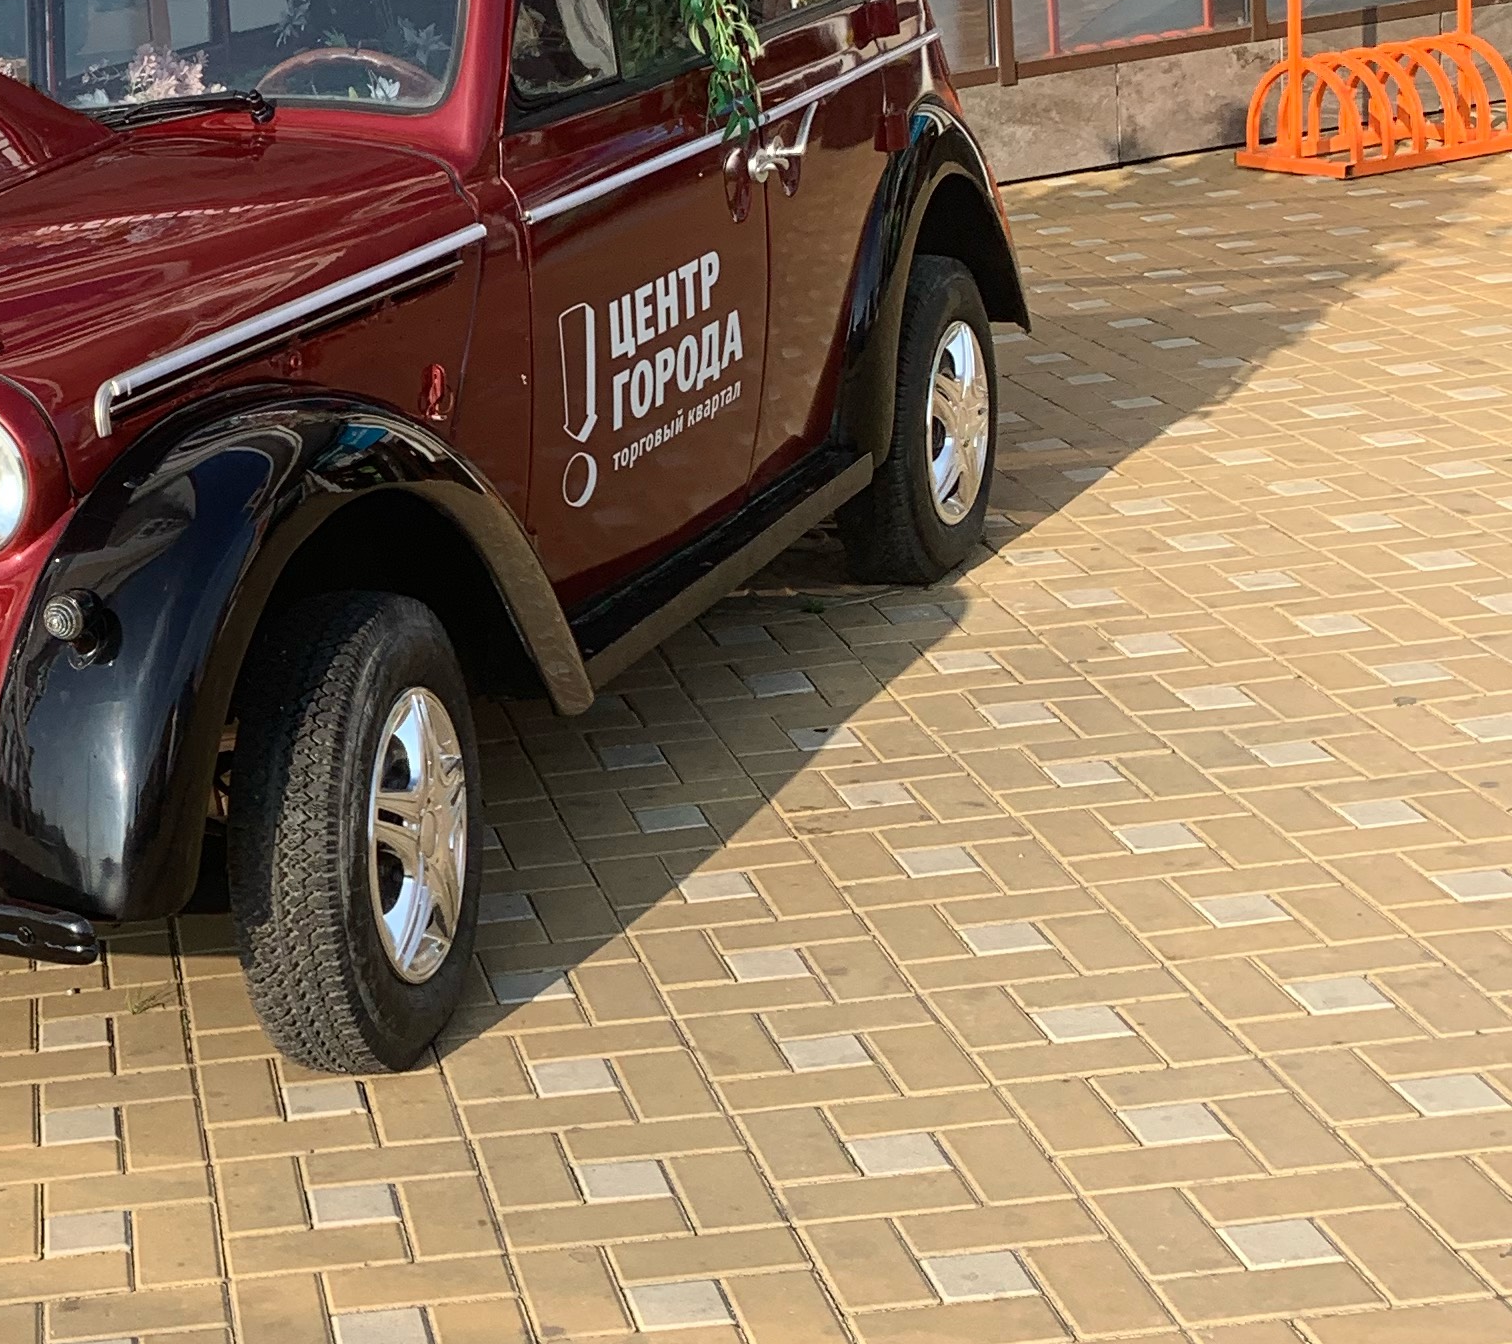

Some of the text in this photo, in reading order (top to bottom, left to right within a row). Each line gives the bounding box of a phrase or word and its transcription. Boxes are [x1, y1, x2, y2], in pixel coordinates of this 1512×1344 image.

[608, 250, 720, 360] ЦЕНТР
[612, 309, 744, 432] ГОРОДА
[612, 380, 742, 471] торговый квартал
